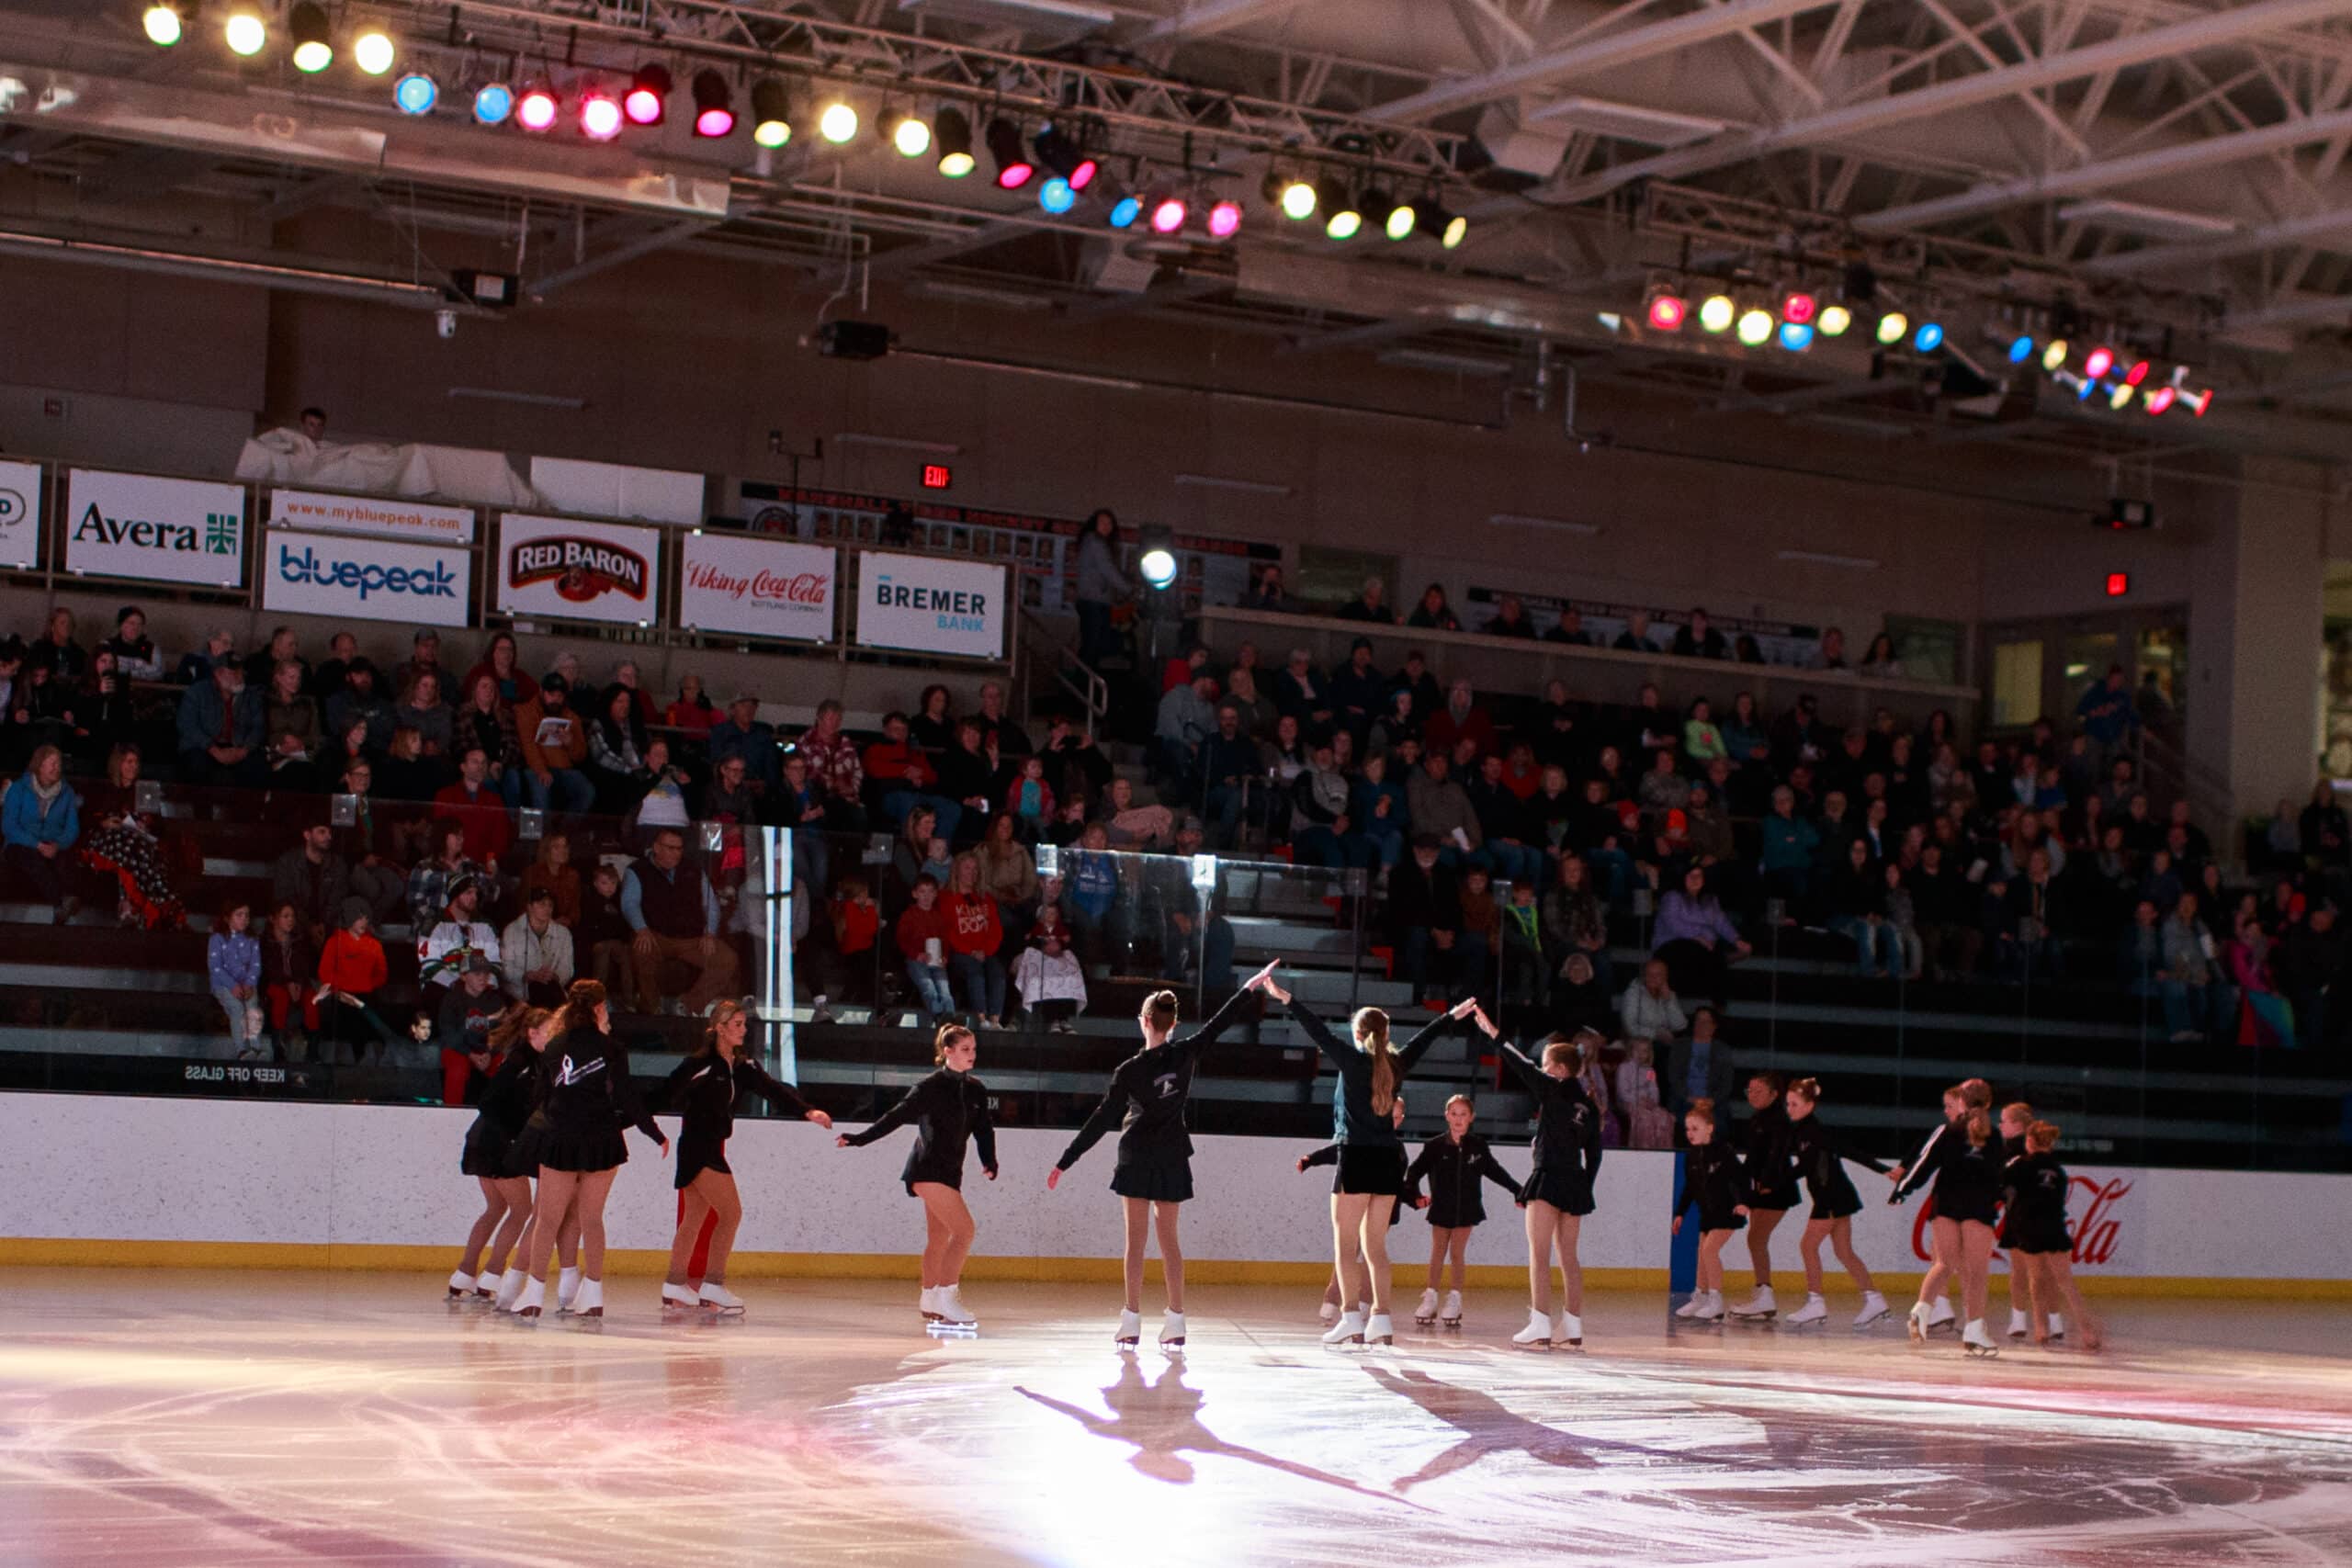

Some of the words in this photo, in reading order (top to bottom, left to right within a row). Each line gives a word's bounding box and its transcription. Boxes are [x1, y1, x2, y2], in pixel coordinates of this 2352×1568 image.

[925, 466, 947, 487] EXIT
[73, 502, 199, 551] Avera
[288, 502, 460, 530] www.mybluepeak.com
[280, 544, 457, 601] bluepeak
[517, 545, 561, 574] RED
[564, 542, 640, 586] BARON
[686, 559, 751, 600] Viking
[877, 584, 986, 615] BREMER
[937, 615, 985, 632] BANK
